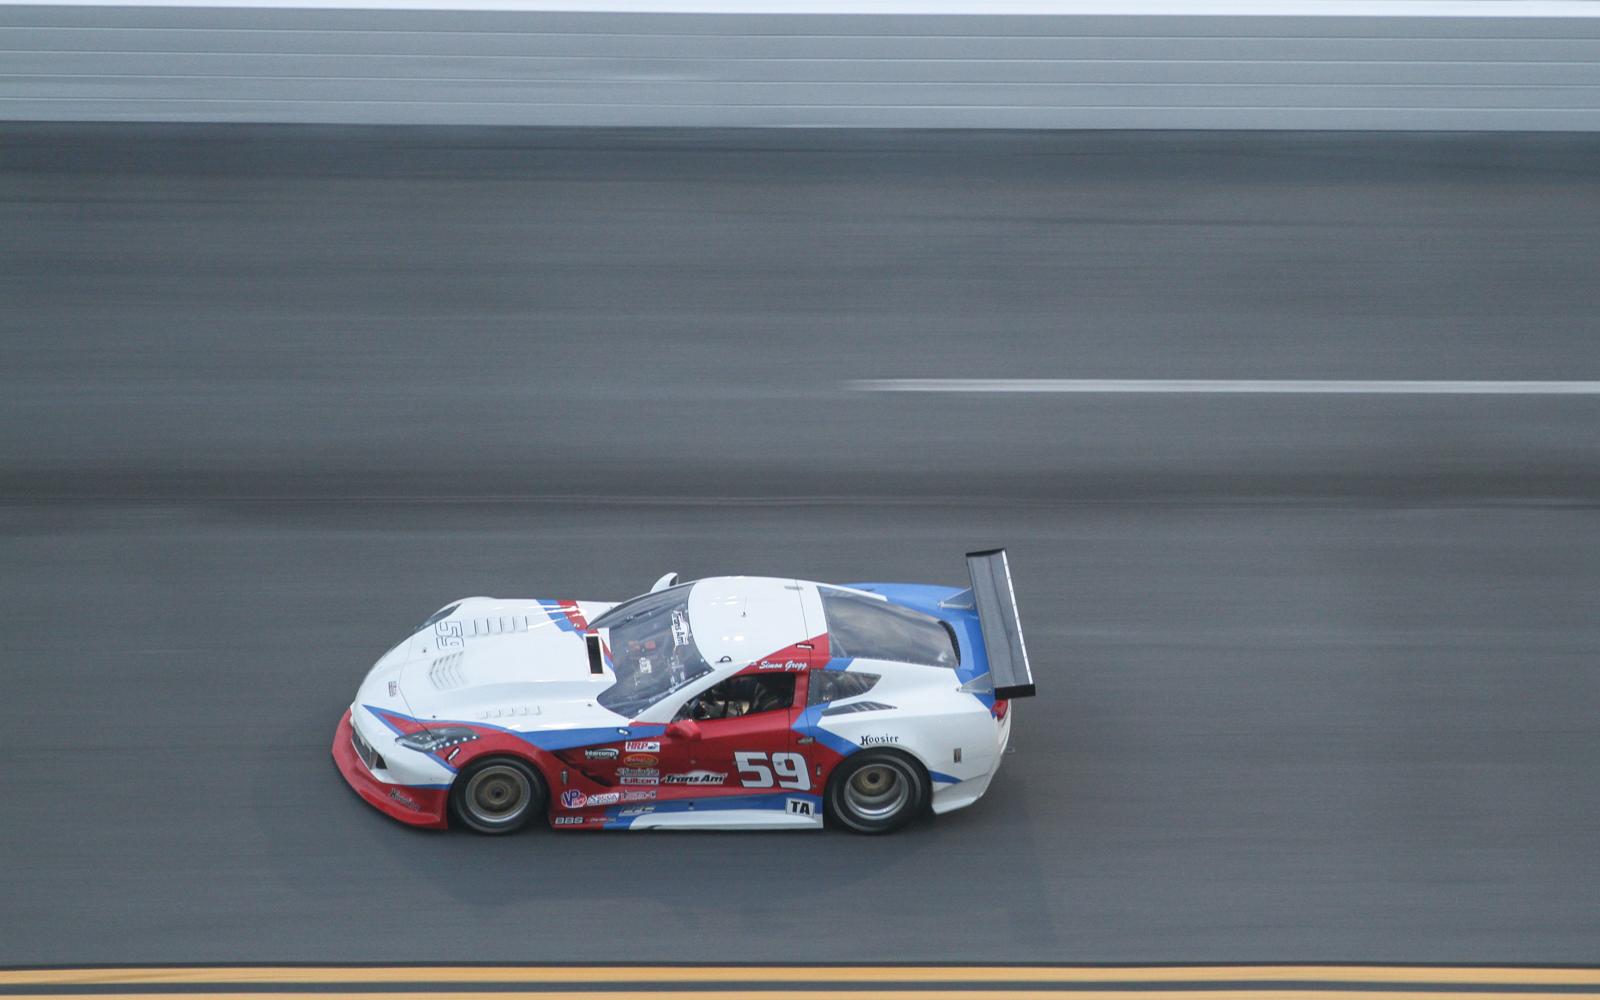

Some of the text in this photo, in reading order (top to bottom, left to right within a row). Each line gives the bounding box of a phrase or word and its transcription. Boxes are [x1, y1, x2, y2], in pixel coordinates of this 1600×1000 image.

[434, 620, 465, 650] 59
[759, 660, 808, 672] Simon Gregg
[860, 733, 900, 746] Hoosier
[734, 751, 811, 791] 59
[666, 773, 724, 784] Trans Am
[790, 800, 810, 815] TA
